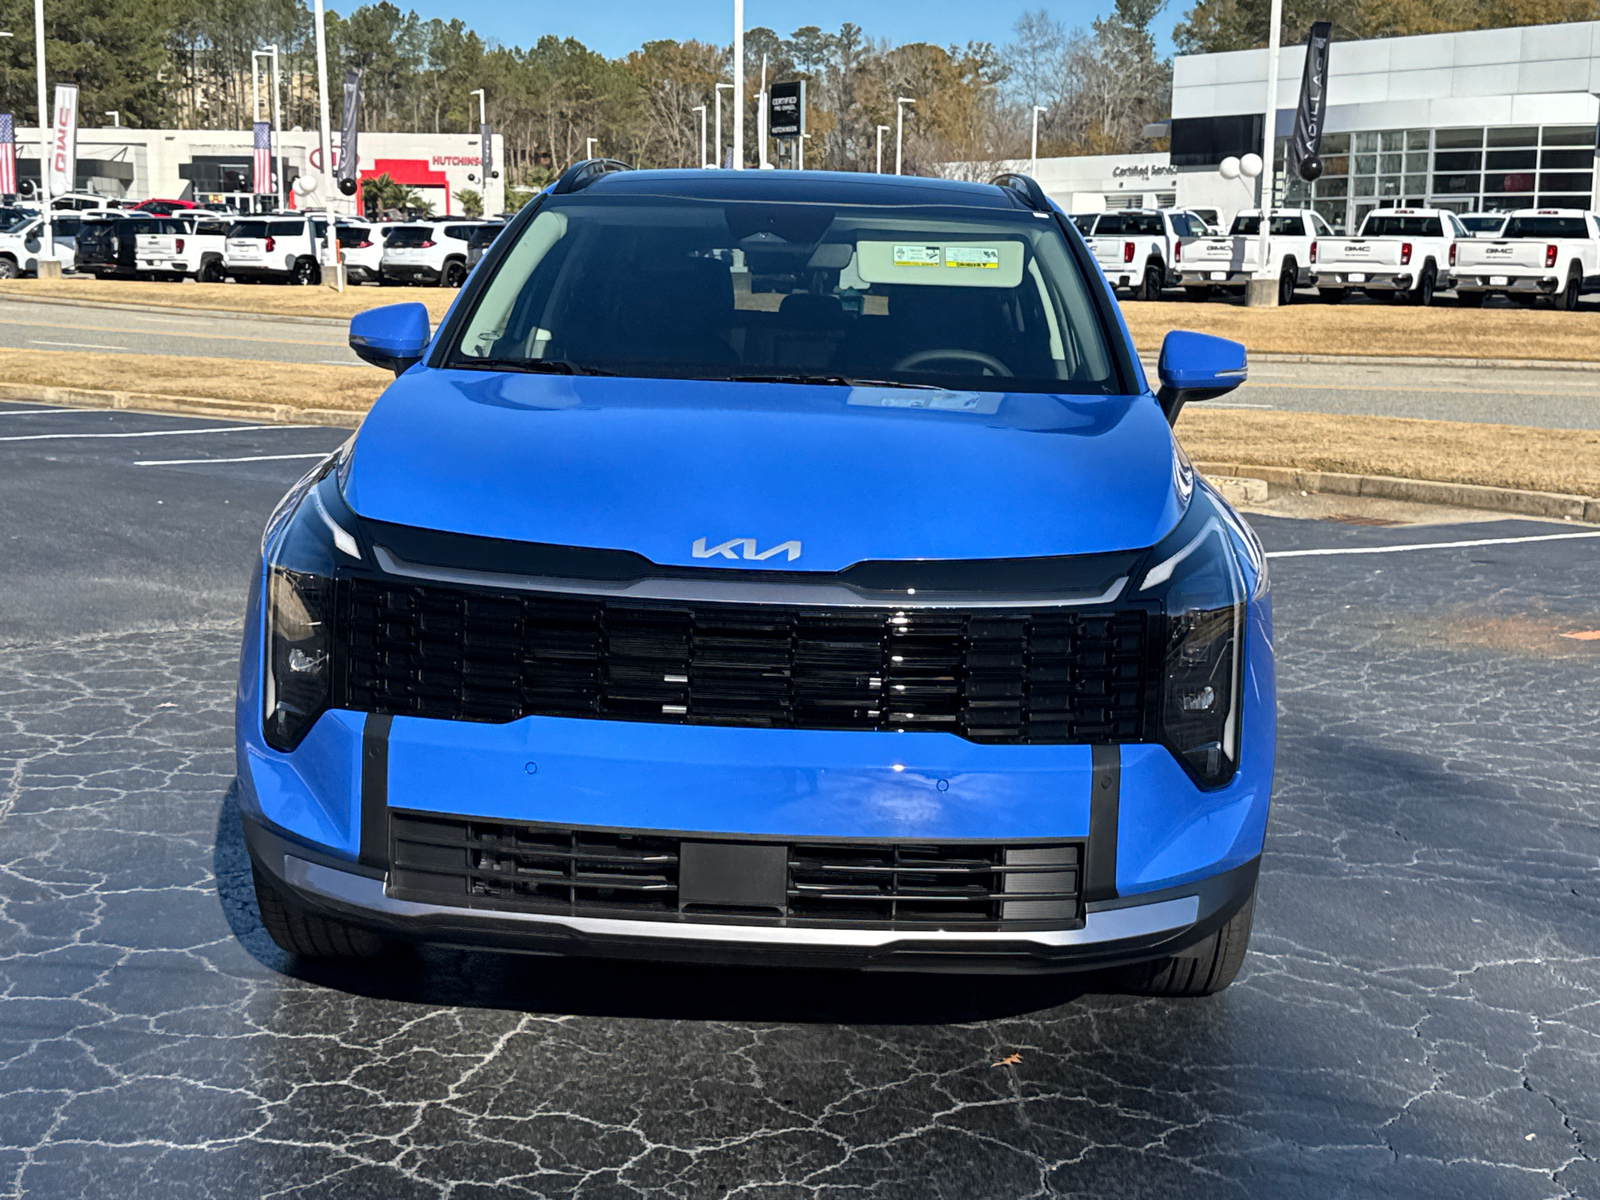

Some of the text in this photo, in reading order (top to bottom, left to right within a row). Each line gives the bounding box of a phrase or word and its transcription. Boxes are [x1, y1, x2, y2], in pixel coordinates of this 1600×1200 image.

[1304, 57, 1324, 158] ADILLAC
[55, 107, 70, 172] GMC
[432, 156, 493, 167] HUTCHINS
[1112, 165, 1149, 178] Certified
[692, 537, 801, 561] KIA
